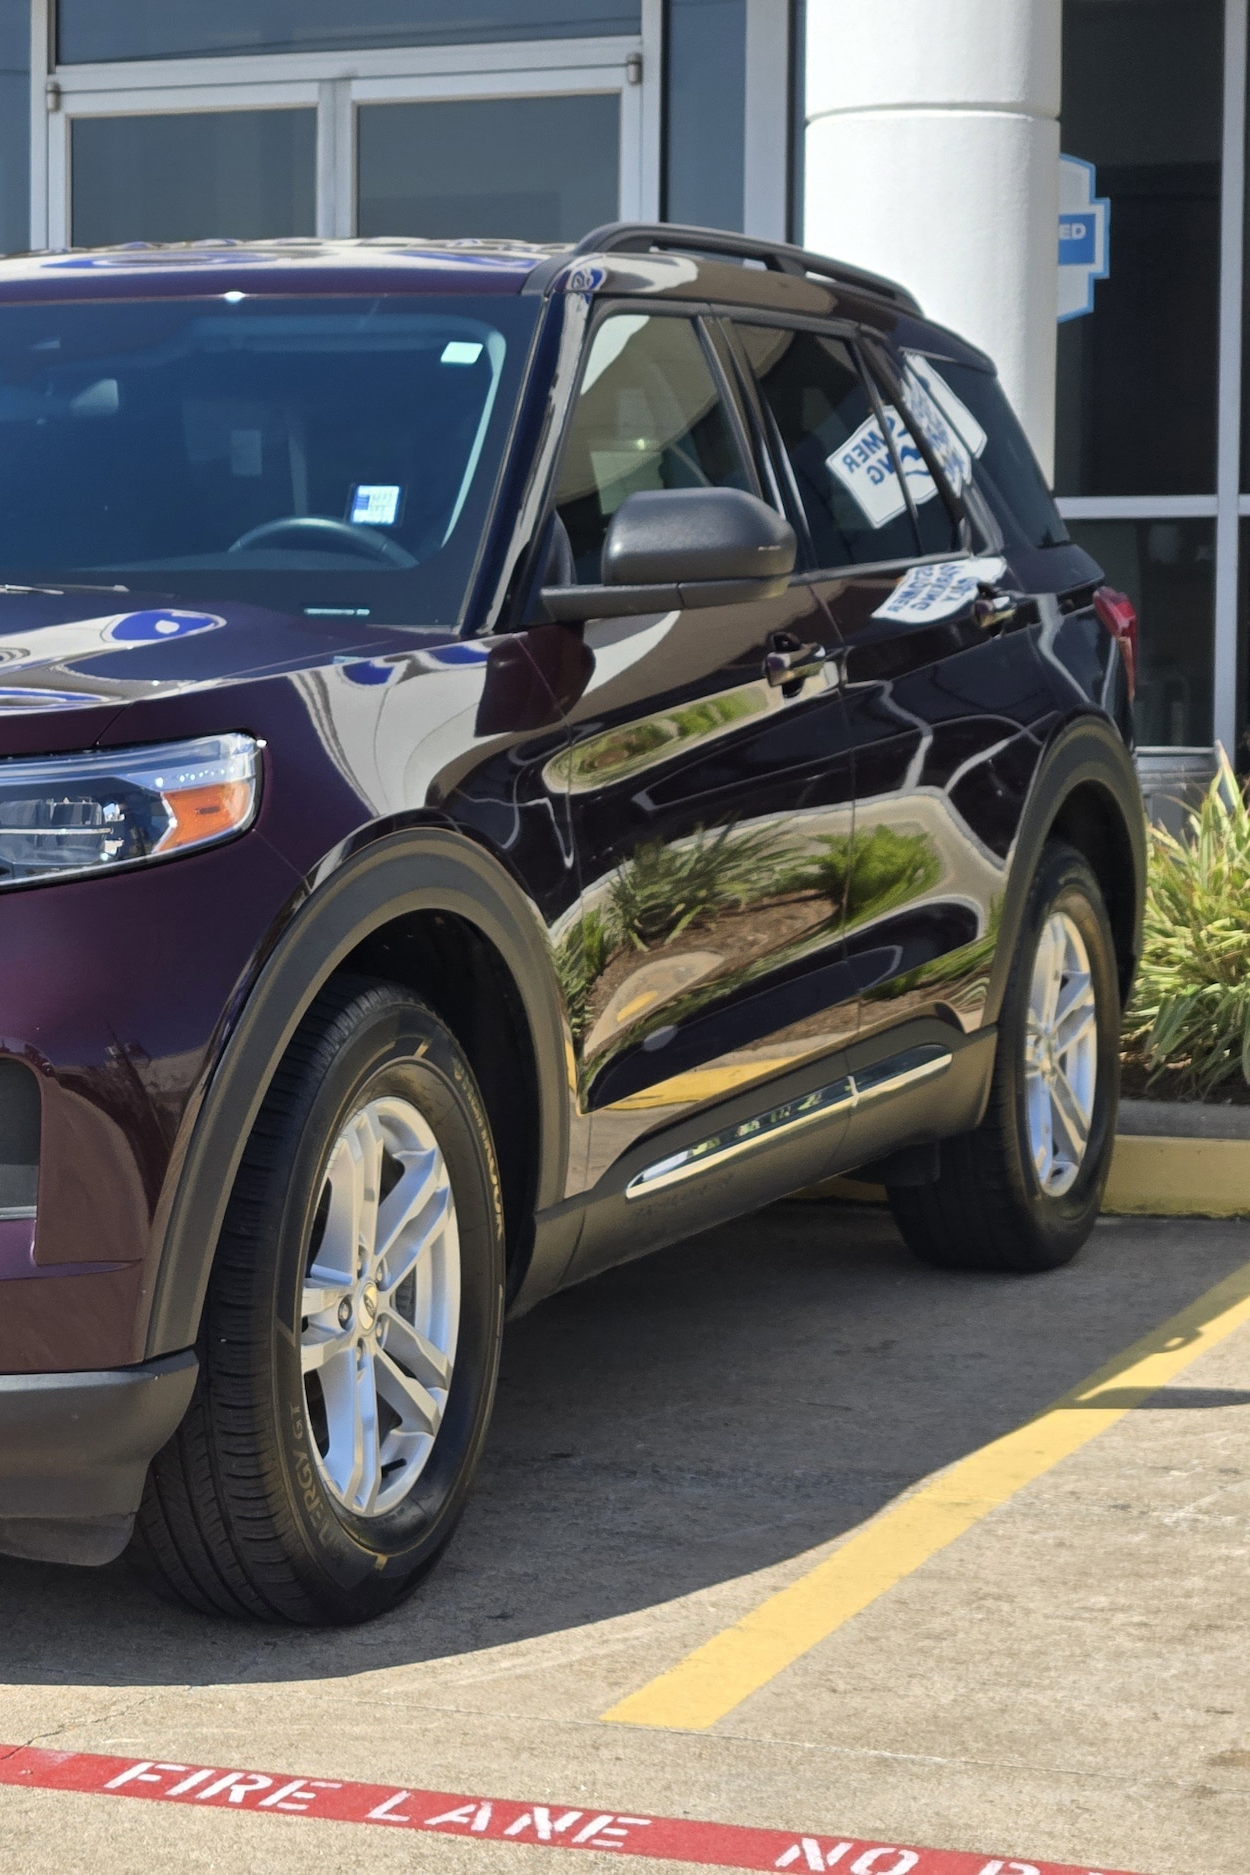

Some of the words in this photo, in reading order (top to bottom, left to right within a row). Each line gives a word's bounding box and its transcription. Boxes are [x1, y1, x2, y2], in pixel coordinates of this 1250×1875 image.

[103, 1761, 342, 1811] FIRE
[365, 1789, 651, 1848] LANE
[775, 1837, 920, 1875] NO
